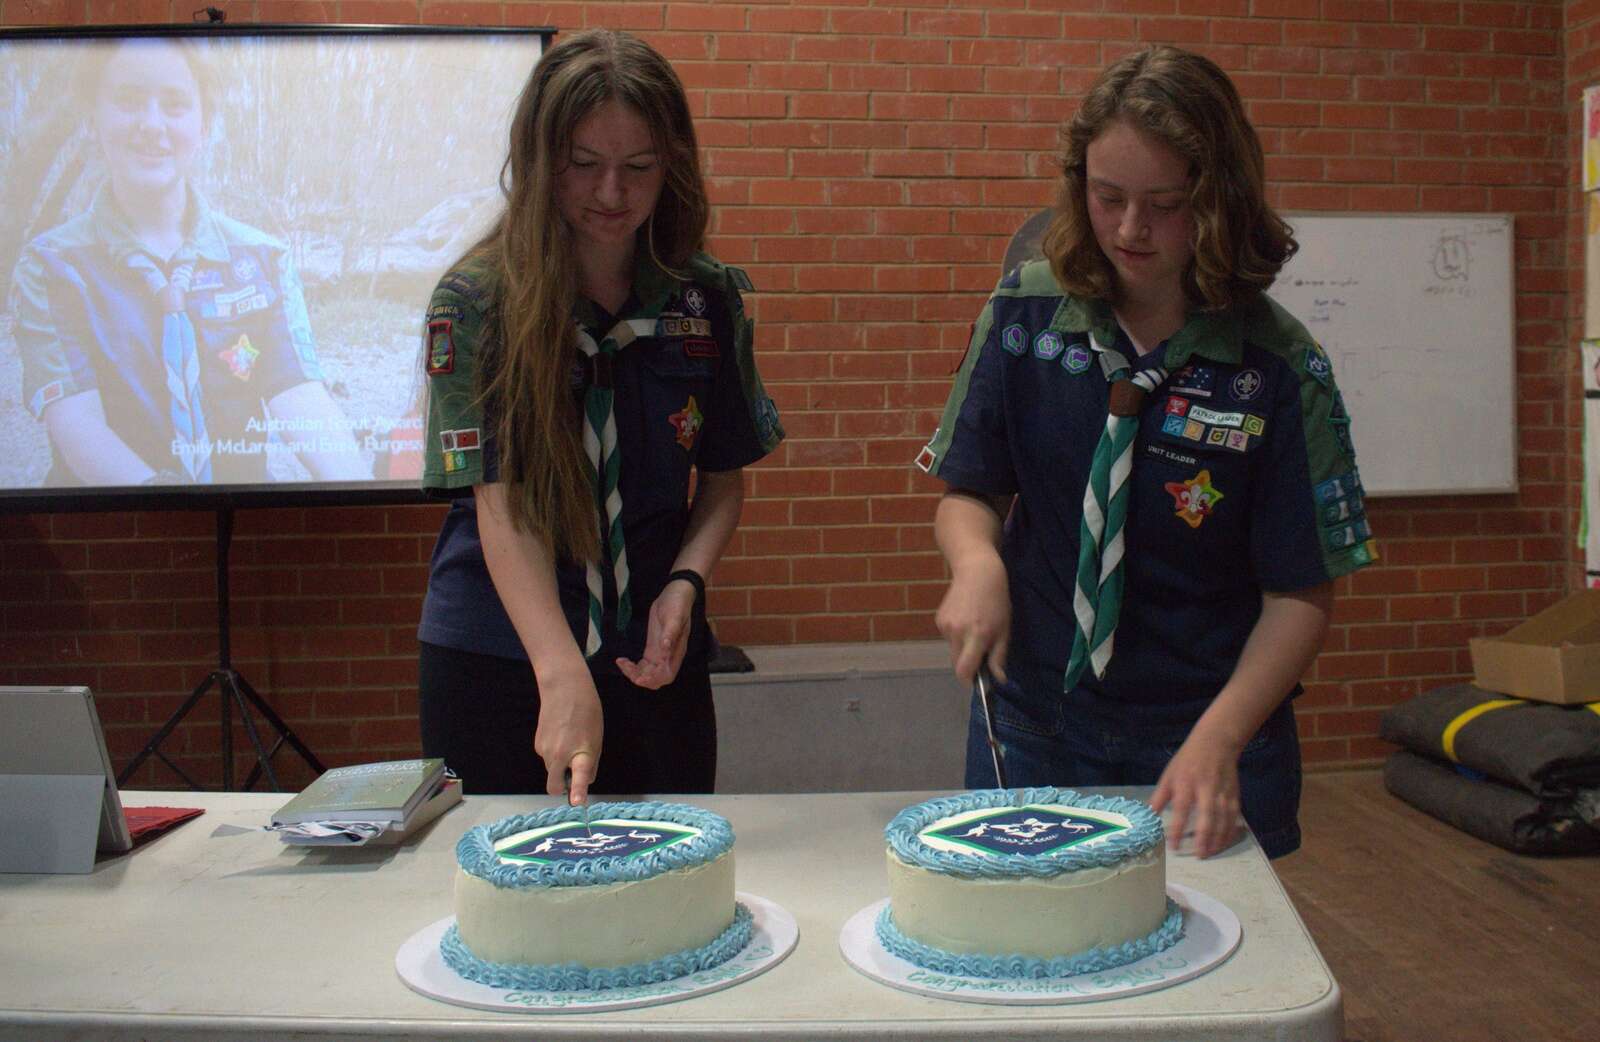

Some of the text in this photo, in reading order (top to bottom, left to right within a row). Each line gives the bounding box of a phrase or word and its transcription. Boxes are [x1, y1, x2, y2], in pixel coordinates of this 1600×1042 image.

[245, 416, 322, 432] Australian
[375, 415, 423, 431] Award
[171, 439, 214, 458] Emily
[217, 438, 283, 454] McLaren
[287, 438, 317, 454] and
[1148, 445, 1197, 465] UNIT LEADER
